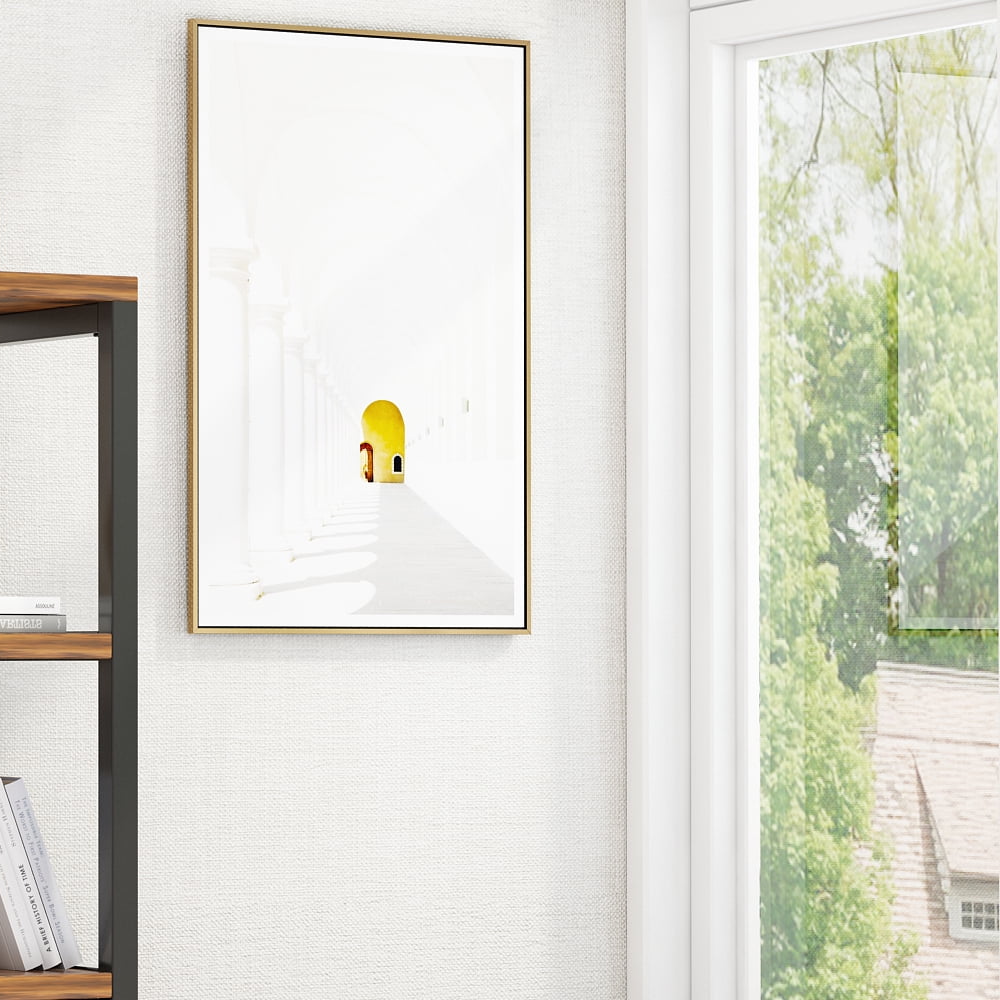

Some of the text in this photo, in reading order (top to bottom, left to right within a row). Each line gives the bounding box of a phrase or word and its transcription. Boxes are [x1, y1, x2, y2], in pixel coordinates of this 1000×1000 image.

[18, 864, 28, 881] TIME
[24, 882, 32, 893] OF
[28, 895, 42, 924] HISTORY
[38, 926, 50, 946] BRIEF
